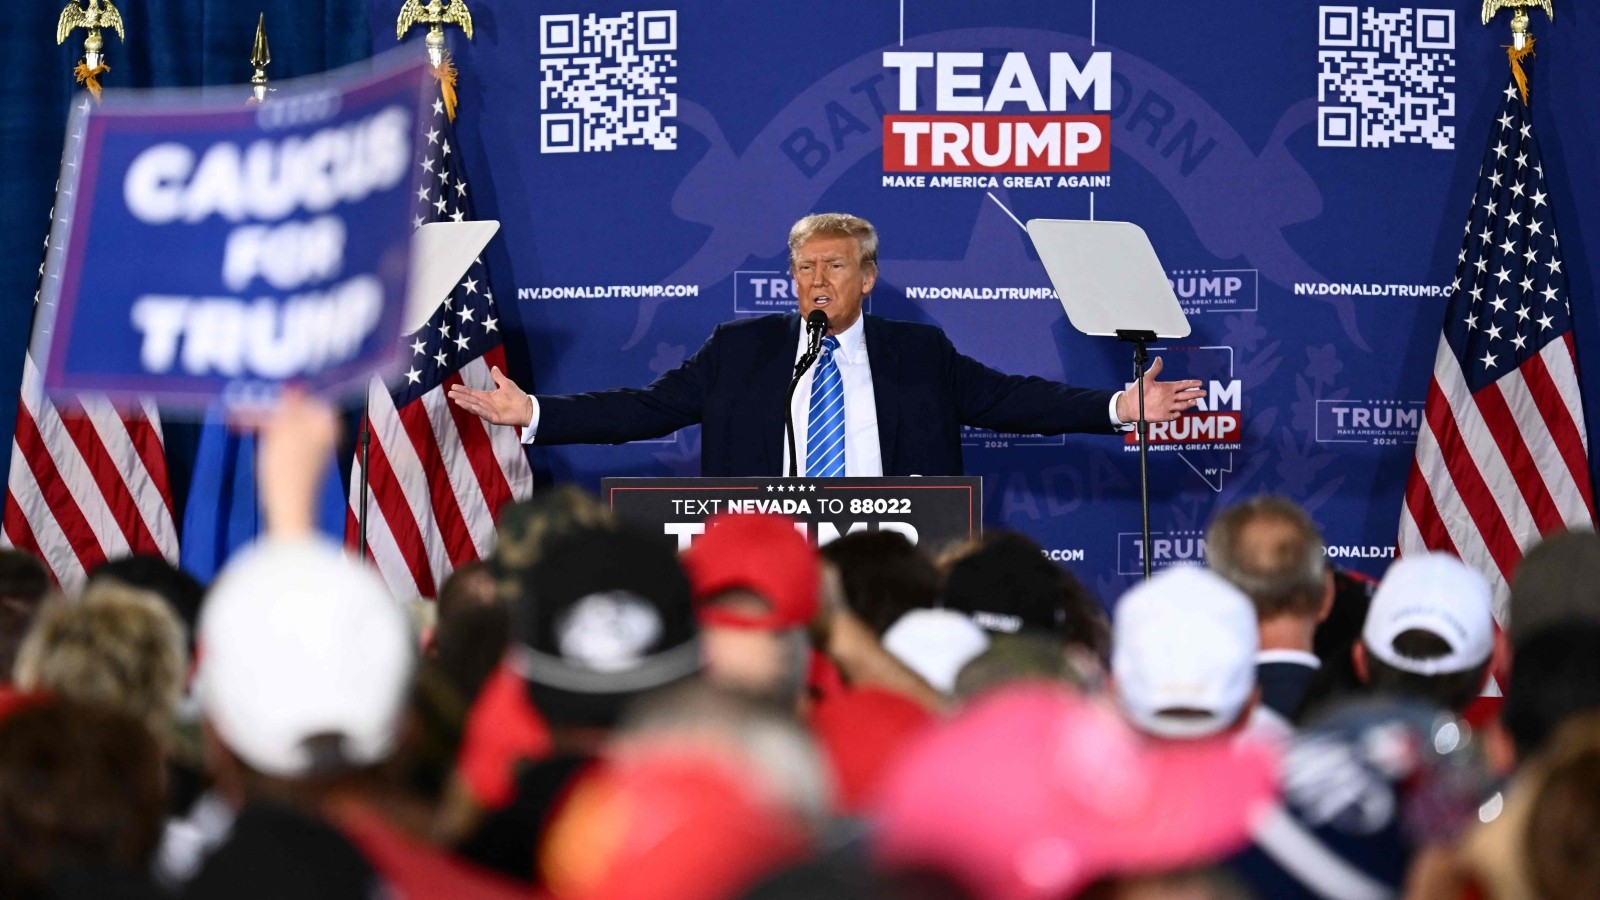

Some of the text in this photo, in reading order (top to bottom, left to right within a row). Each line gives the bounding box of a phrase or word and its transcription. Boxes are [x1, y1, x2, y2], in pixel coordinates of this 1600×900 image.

[883, 52, 1111, 111] TEAM
[892, 122, 1101, 167] TRUMP
[125, 108, 409, 223] CAUCUS
[882, 176, 1110, 188] MAKE AMERICA GREAT AGAIN!
[223, 215, 345, 291] FOR
[518, 284, 699, 300] NV.DONALDJTRUMP.COM
[906, 286, 1059, 300] NV.DONALDJTRUMP.
[1168, 277, 1242, 298] UMP
[1294, 283, 1452, 298] NV.DONALDJTRUMP.C
[131, 276, 384, 379] TRUMP
[1332, 407, 1424, 429] TRUM
[1124, 443, 1241, 453] MAK AMERICA GREAT AGAIN!
[1373, 438, 1397, 446] 2024
[1205, 468, 1217, 476] NV
[672, 498, 912, 515] TEXT NEVADA TO 88022
